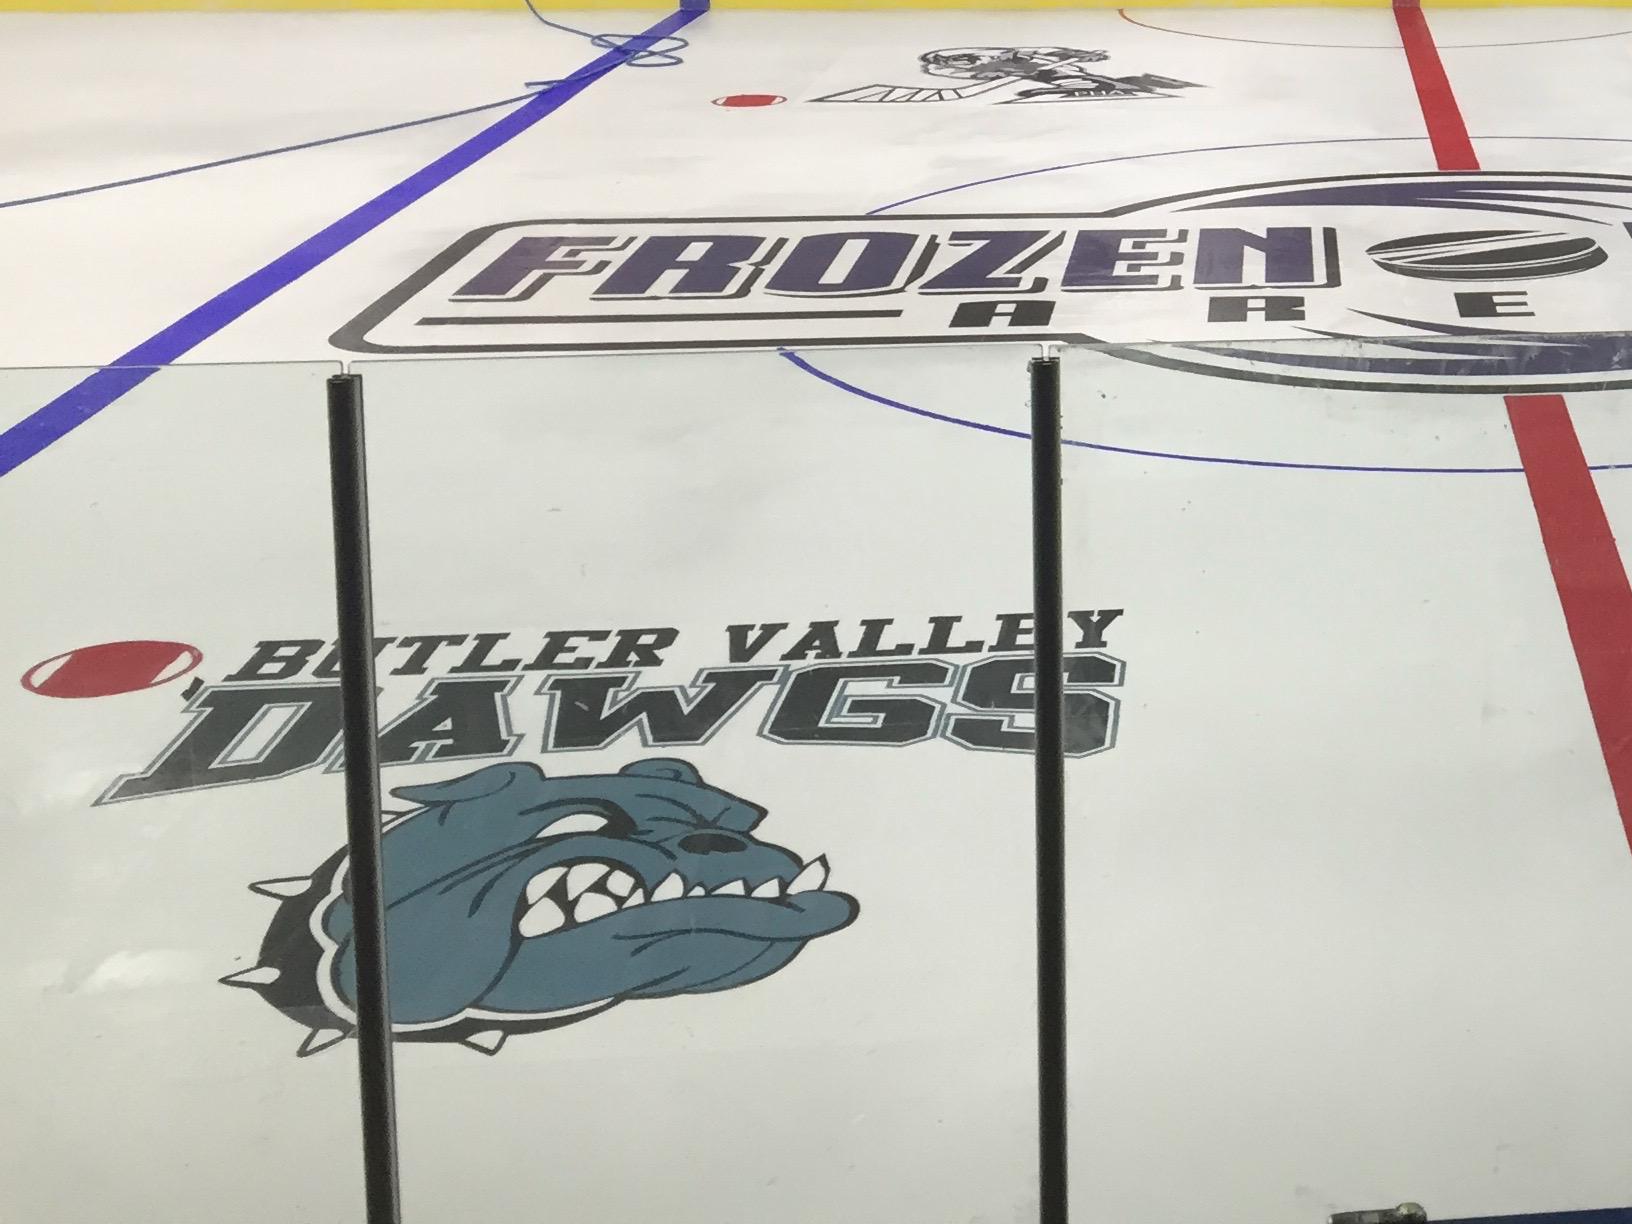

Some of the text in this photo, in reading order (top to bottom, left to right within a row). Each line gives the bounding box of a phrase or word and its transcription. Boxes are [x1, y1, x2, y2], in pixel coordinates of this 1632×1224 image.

[448, 224, 1342, 302] FROZEN
[222, 608, 1125, 681] BUTLER VALLEY
[90, 651, 1128, 807] DAWGS
